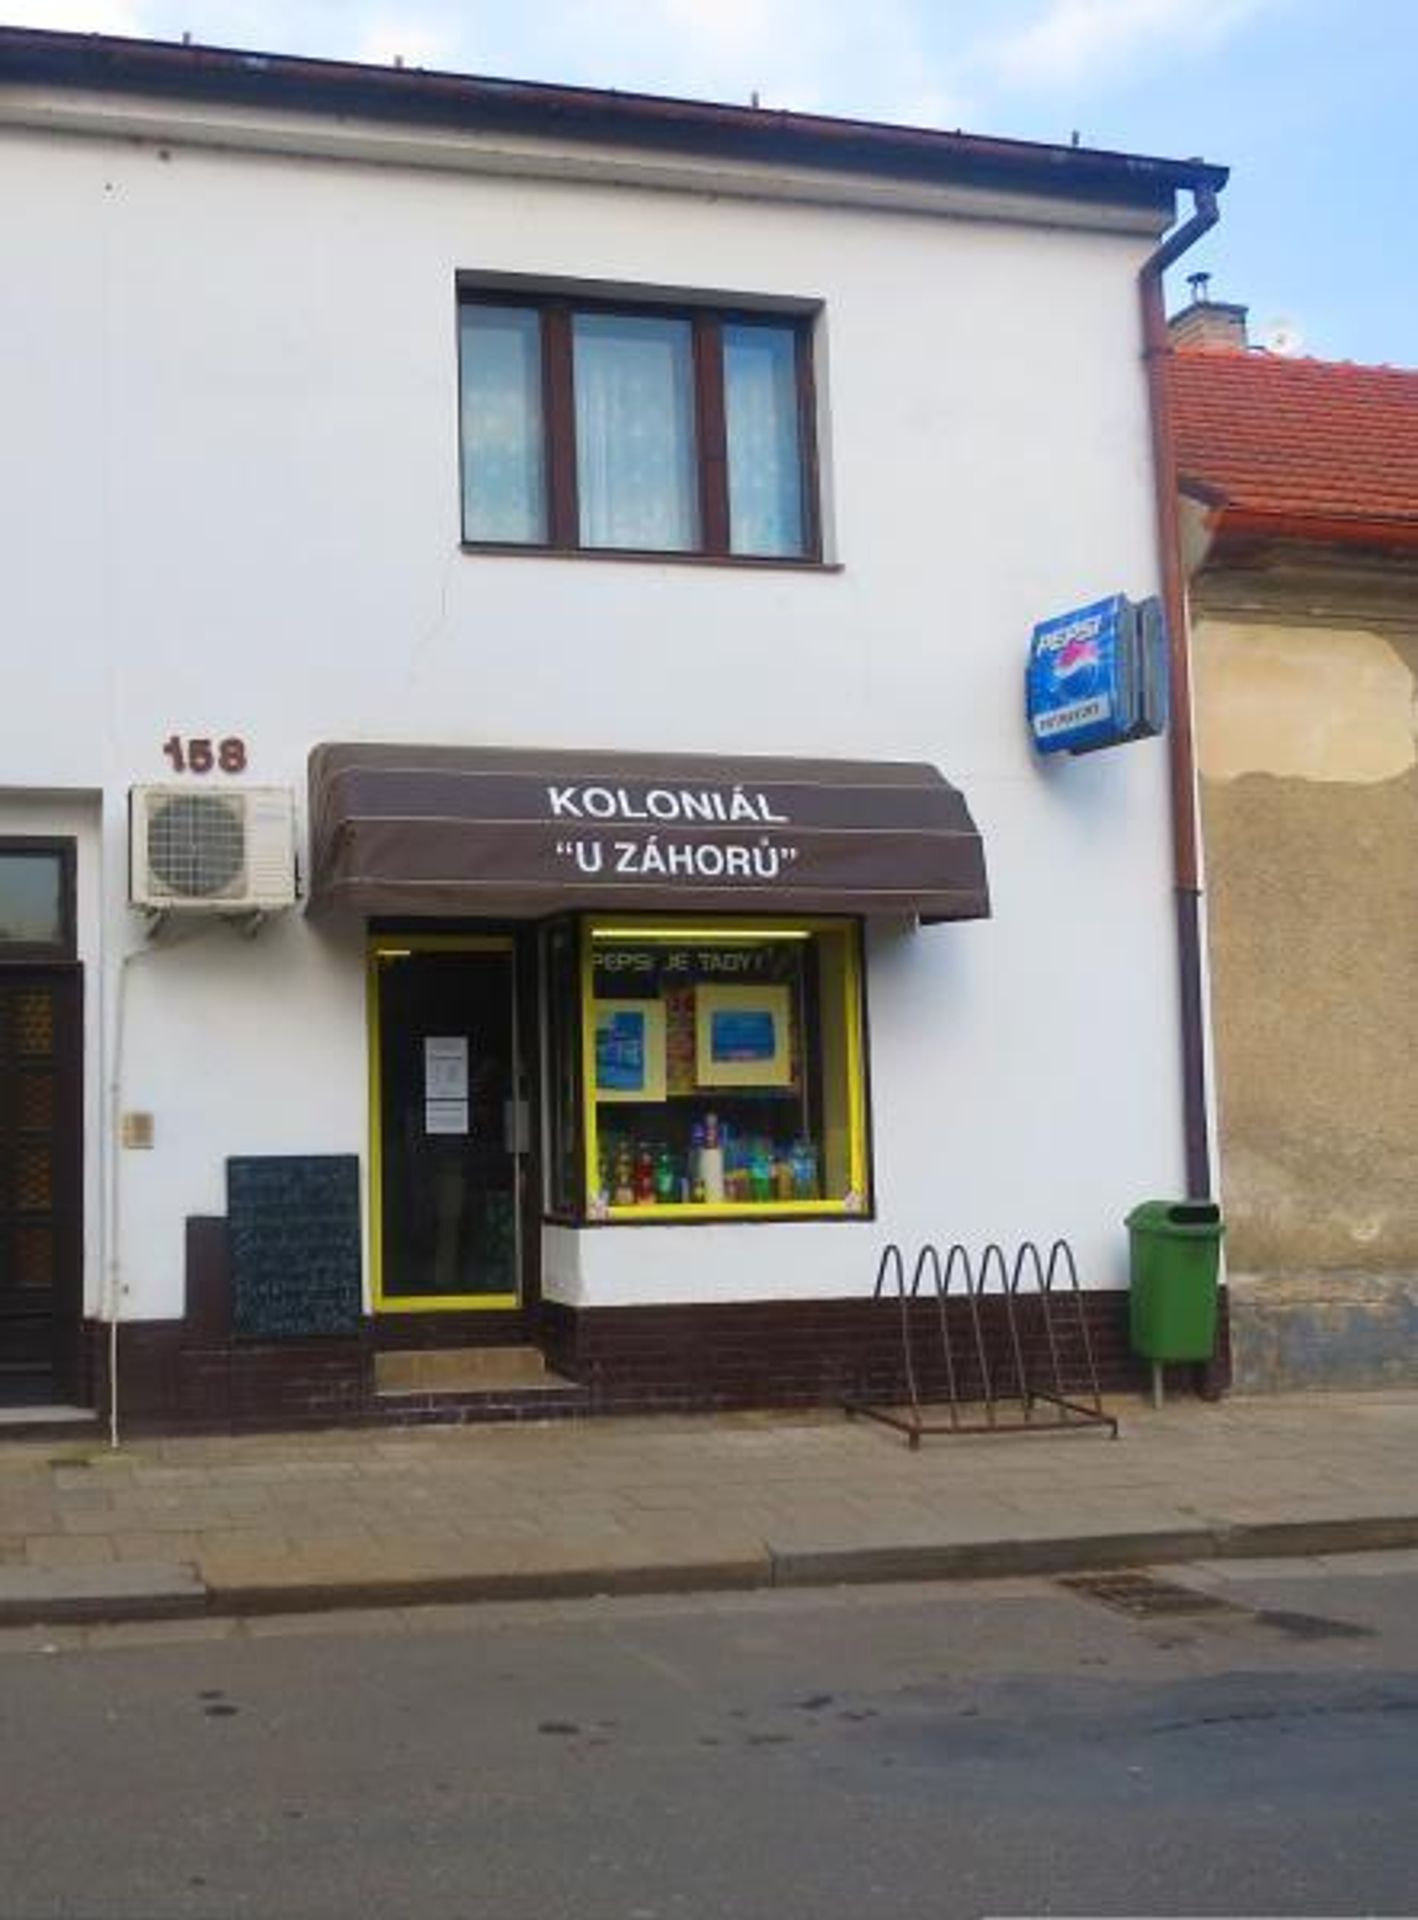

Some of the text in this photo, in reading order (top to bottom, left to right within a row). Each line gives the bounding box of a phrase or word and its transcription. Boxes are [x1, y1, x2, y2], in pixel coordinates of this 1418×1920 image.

[163, 736, 247, 774] 158
[547, 785, 790, 822] KOLONIÁL
[664, 952, 690, 970] JE
